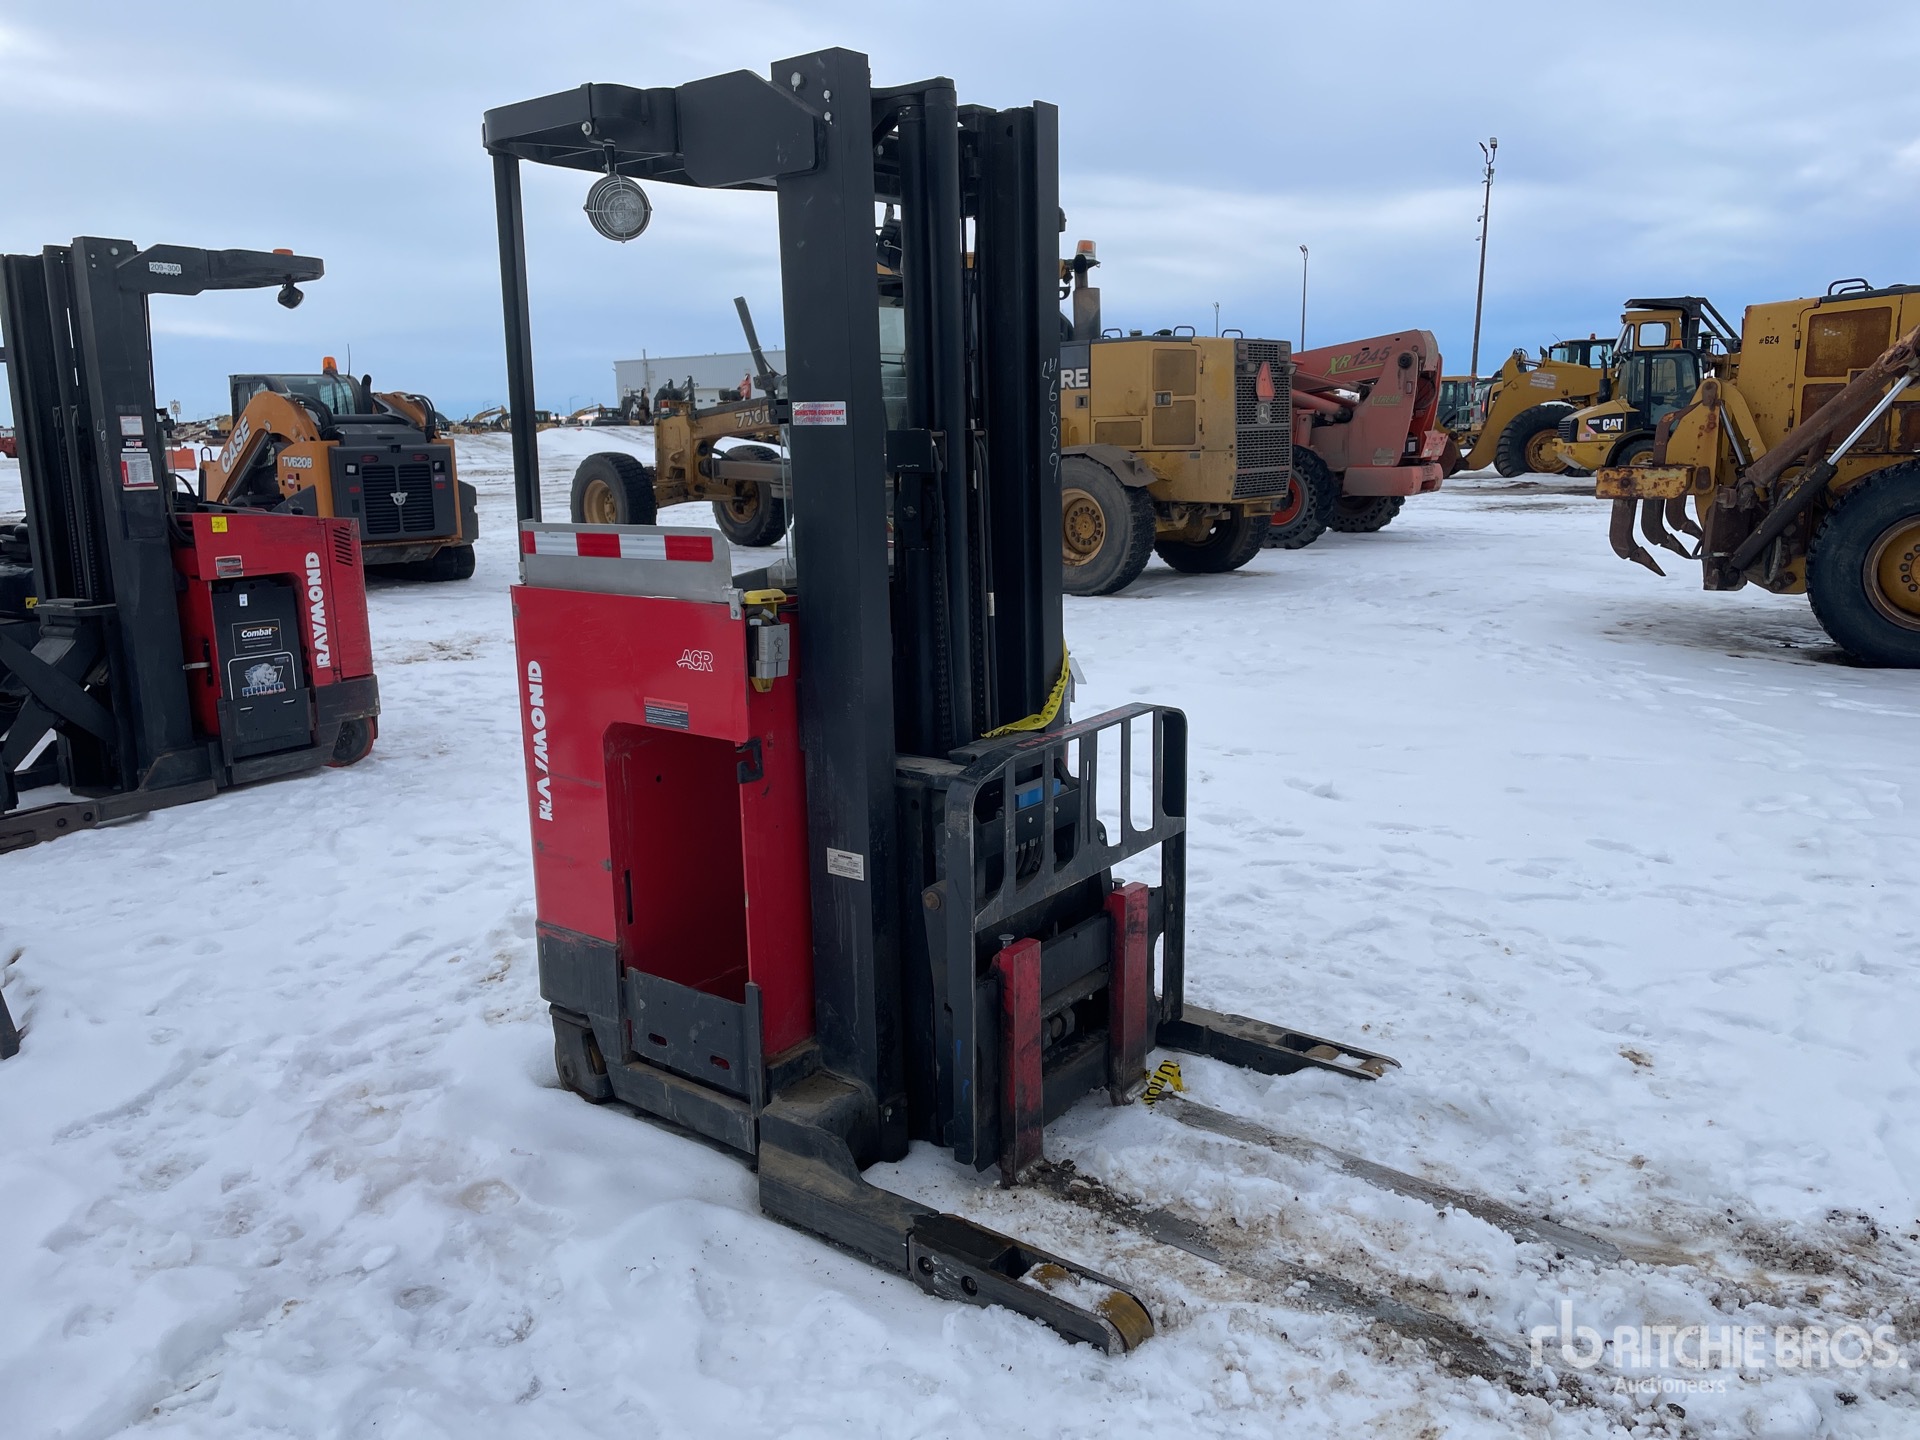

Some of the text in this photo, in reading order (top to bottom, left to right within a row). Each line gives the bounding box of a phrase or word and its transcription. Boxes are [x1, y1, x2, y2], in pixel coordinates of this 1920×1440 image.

[1759, 336, 1779, 344] #624
[1602, 418, 1623, 431] CAT
[222, 416, 251, 473] CASE
[282, 456, 313, 468] TV620B
[305, 551, 331, 669] RAYMOND
[241, 627, 273, 638] Combat
[676, 649, 713, 671] ACR
[527, 660, 554, 821] RAYMOND
